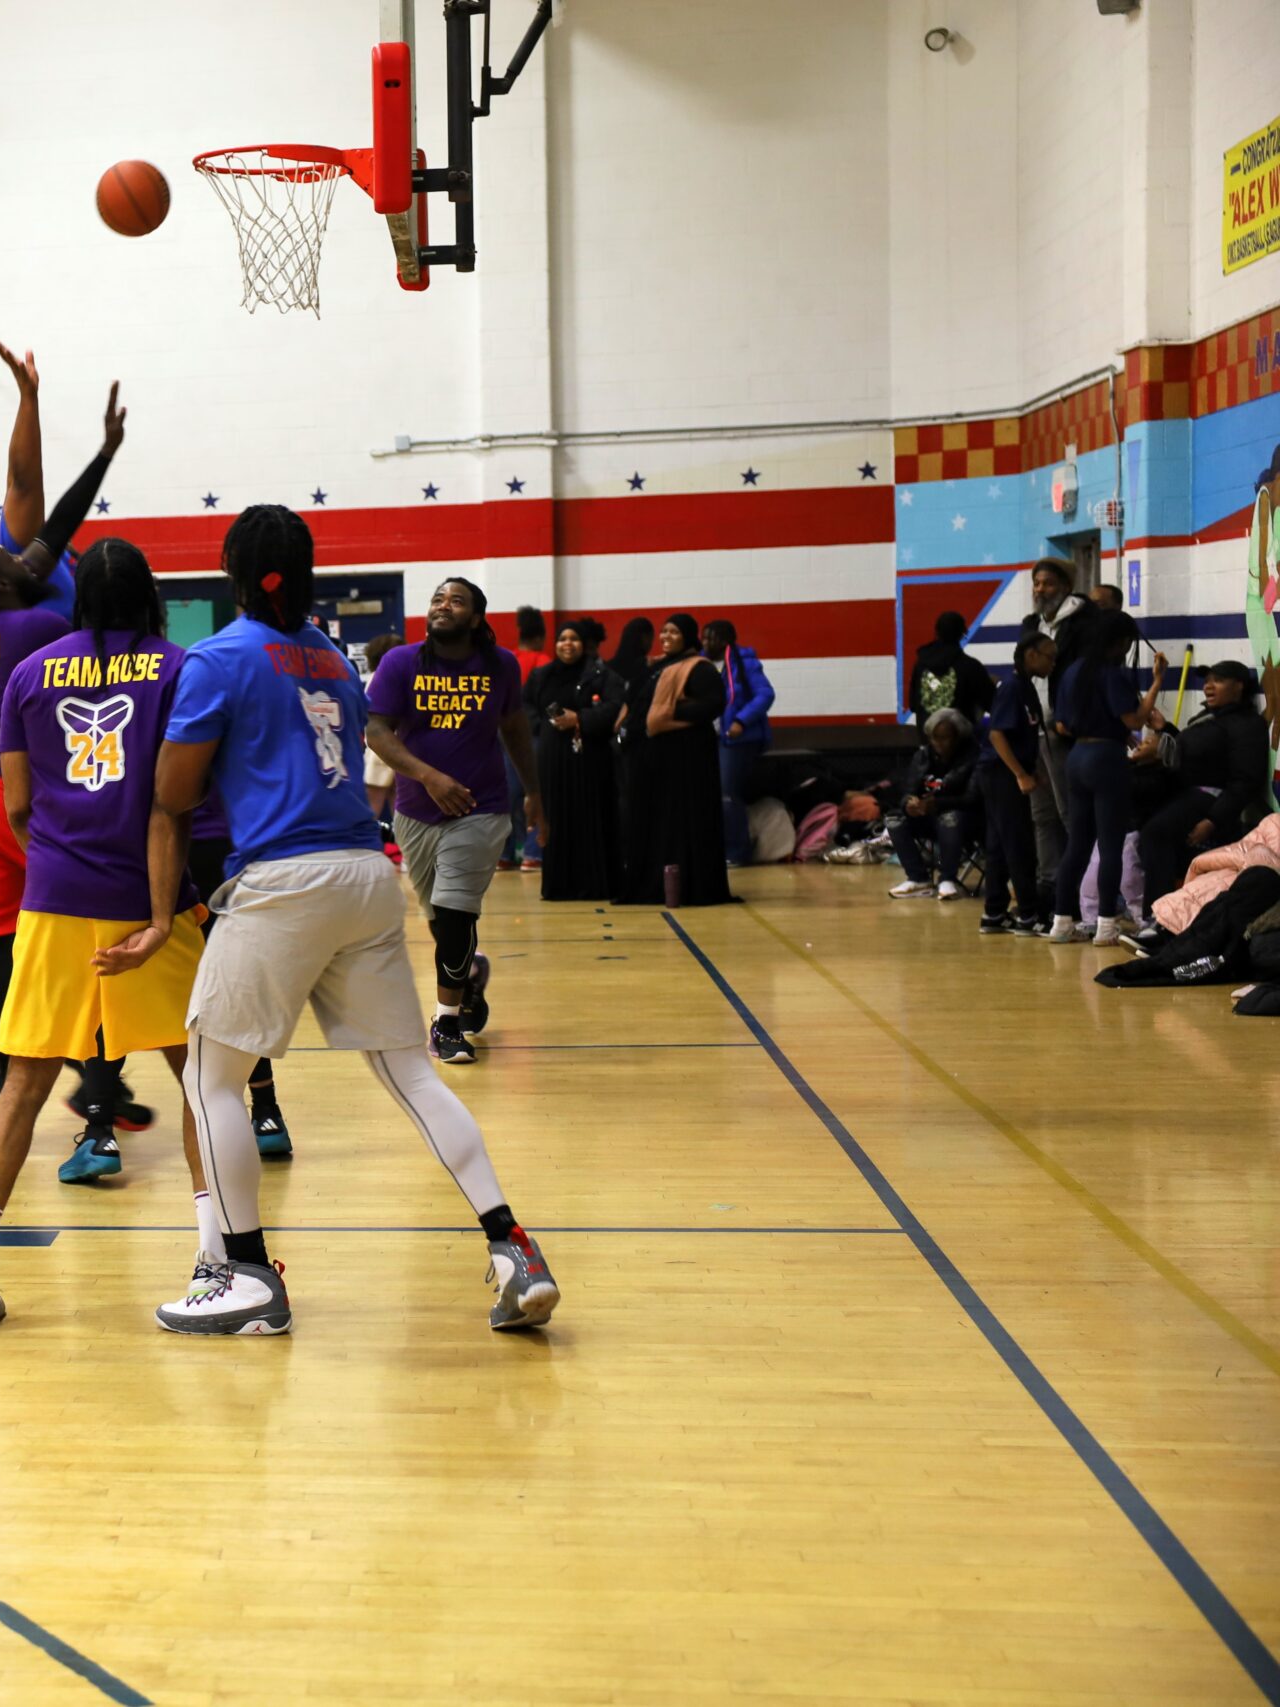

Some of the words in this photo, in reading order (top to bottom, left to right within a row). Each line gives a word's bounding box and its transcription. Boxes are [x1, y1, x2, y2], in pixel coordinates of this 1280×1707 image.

[43, 656, 102, 688] TEAM
[106, 653, 164, 685] KOBE
[413, 675, 491, 692] ATHLETE
[415, 694, 486, 711] LEGACY
[430, 713, 466, 729] DAY
[70, 732, 120, 778] 24
